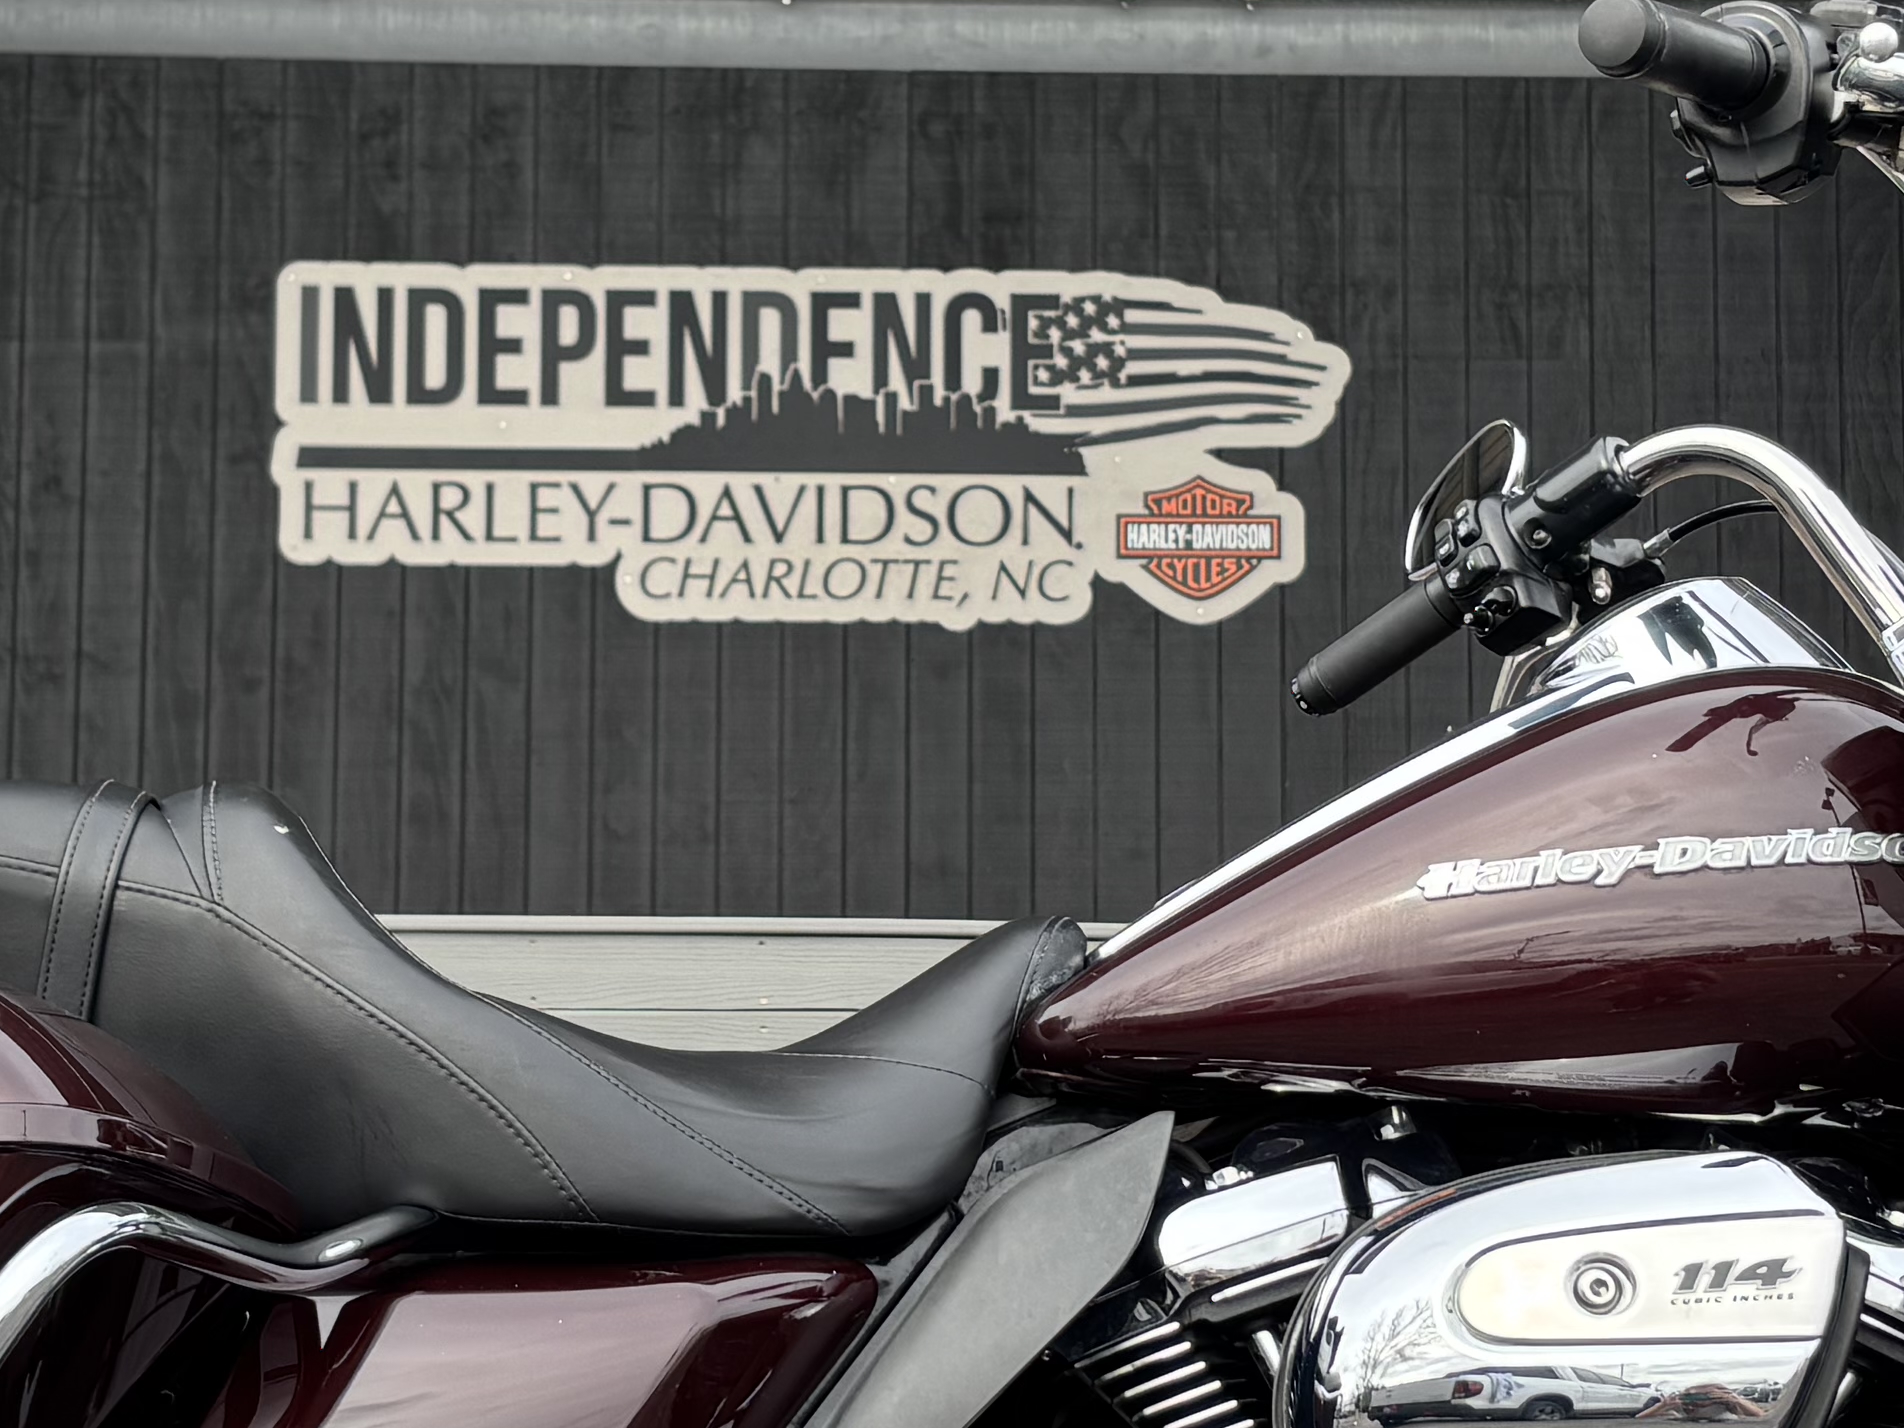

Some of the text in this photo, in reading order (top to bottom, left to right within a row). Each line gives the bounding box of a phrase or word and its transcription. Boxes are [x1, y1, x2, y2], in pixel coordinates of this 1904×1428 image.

[299, 284, 1062, 414] INDEPENDENCE
[1161, 487, 1238, 516] MOTOR
[1126, 523, 1272, 550] HARLEY-DAVIDSON
[642, 556, 1075, 607] CHARLOTTE, NC
[1161, 558, 1238, 590] CYCLES
[1672, 1255, 1803, 1294] 114
[1670, 1292, 1795, 1306] CUBIC INCHES
